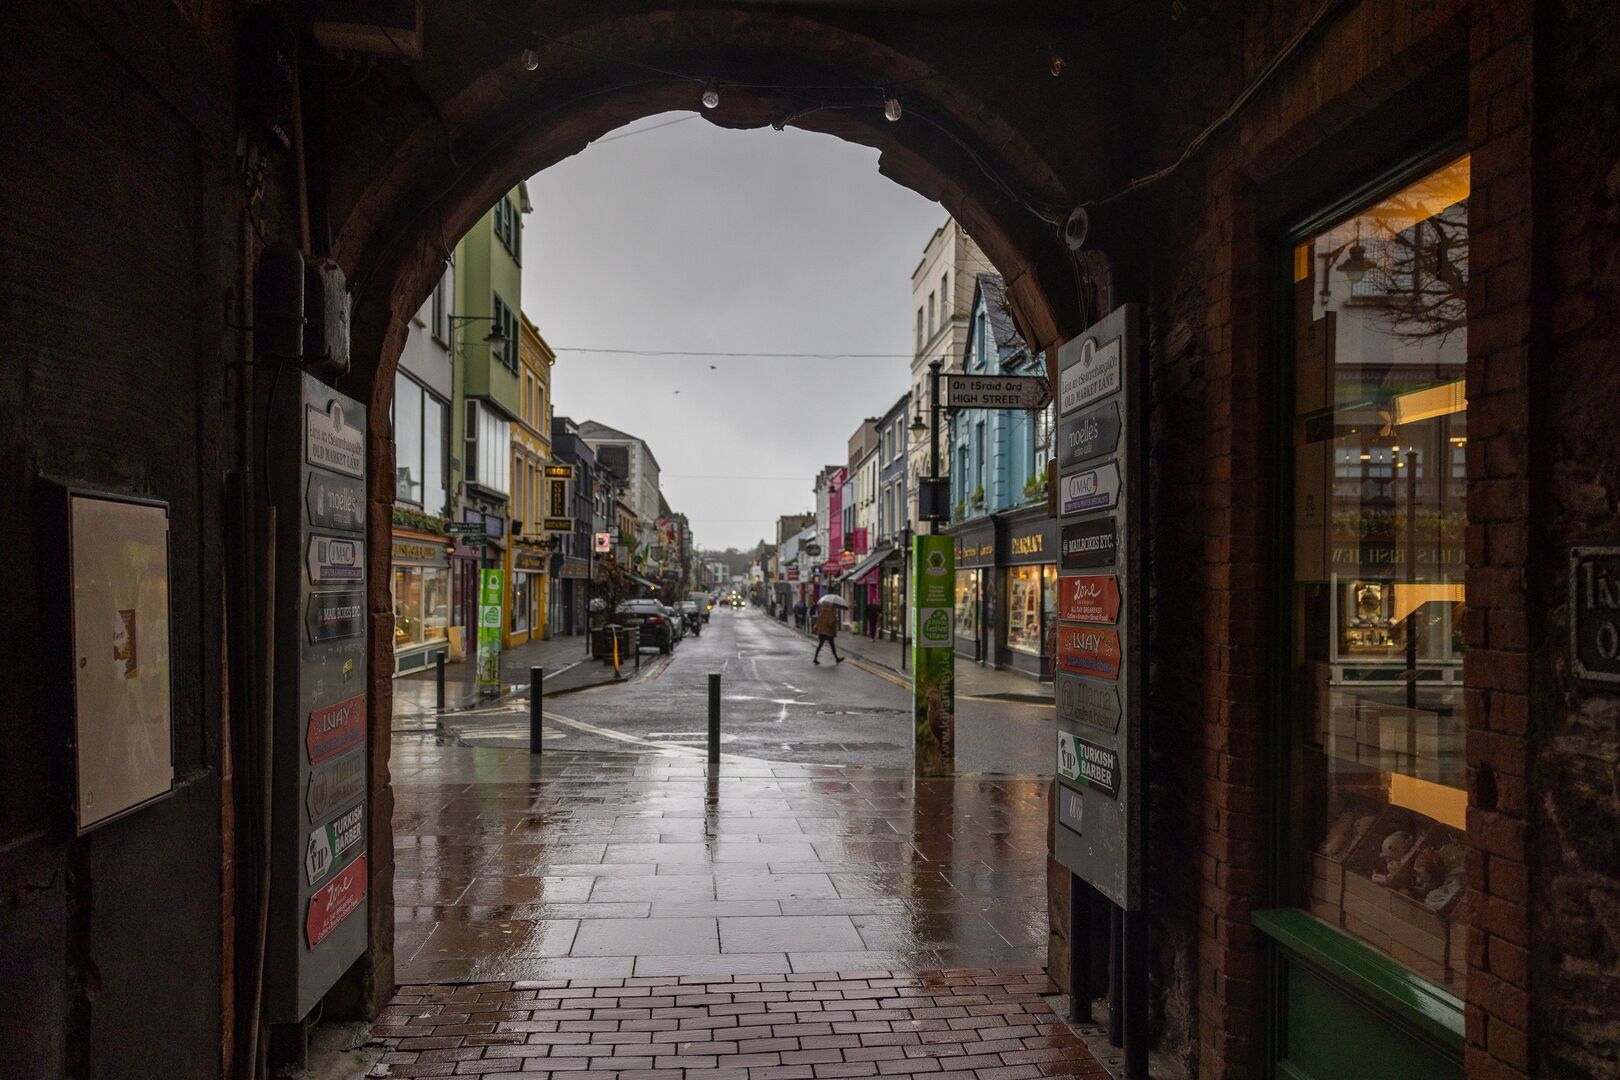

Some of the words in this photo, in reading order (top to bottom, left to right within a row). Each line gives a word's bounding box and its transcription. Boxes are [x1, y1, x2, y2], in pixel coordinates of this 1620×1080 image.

[953, 394, 977, 403] HIGH
[983, 394, 1020, 404] STREET
[1065, 393, 1076, 408] OLD
[1077, 382, 1097, 401] MARKET
[1099, 374, 1114, 391] LANE
[1069, 417, 1099, 447] noelle's
[313, 444, 324, 459] OLD
[326, 447, 346, 467] MARKET
[347, 456, 360, 471] LANE
[1077, 477, 1092, 494] MAC
[328, 488, 356, 512] noelle's
[336, 546, 351, 561] MAC
[1073, 580, 1102, 601] Zone
[1597, 622, 1620, 659] O
[1079, 743, 1114, 770] TURKISH
[1081, 760, 1112, 786] BARBER
[333, 804, 363, 837] TURKISH
[334, 822, 362, 854] BARBER
[326, 875, 354, 912] Zone
